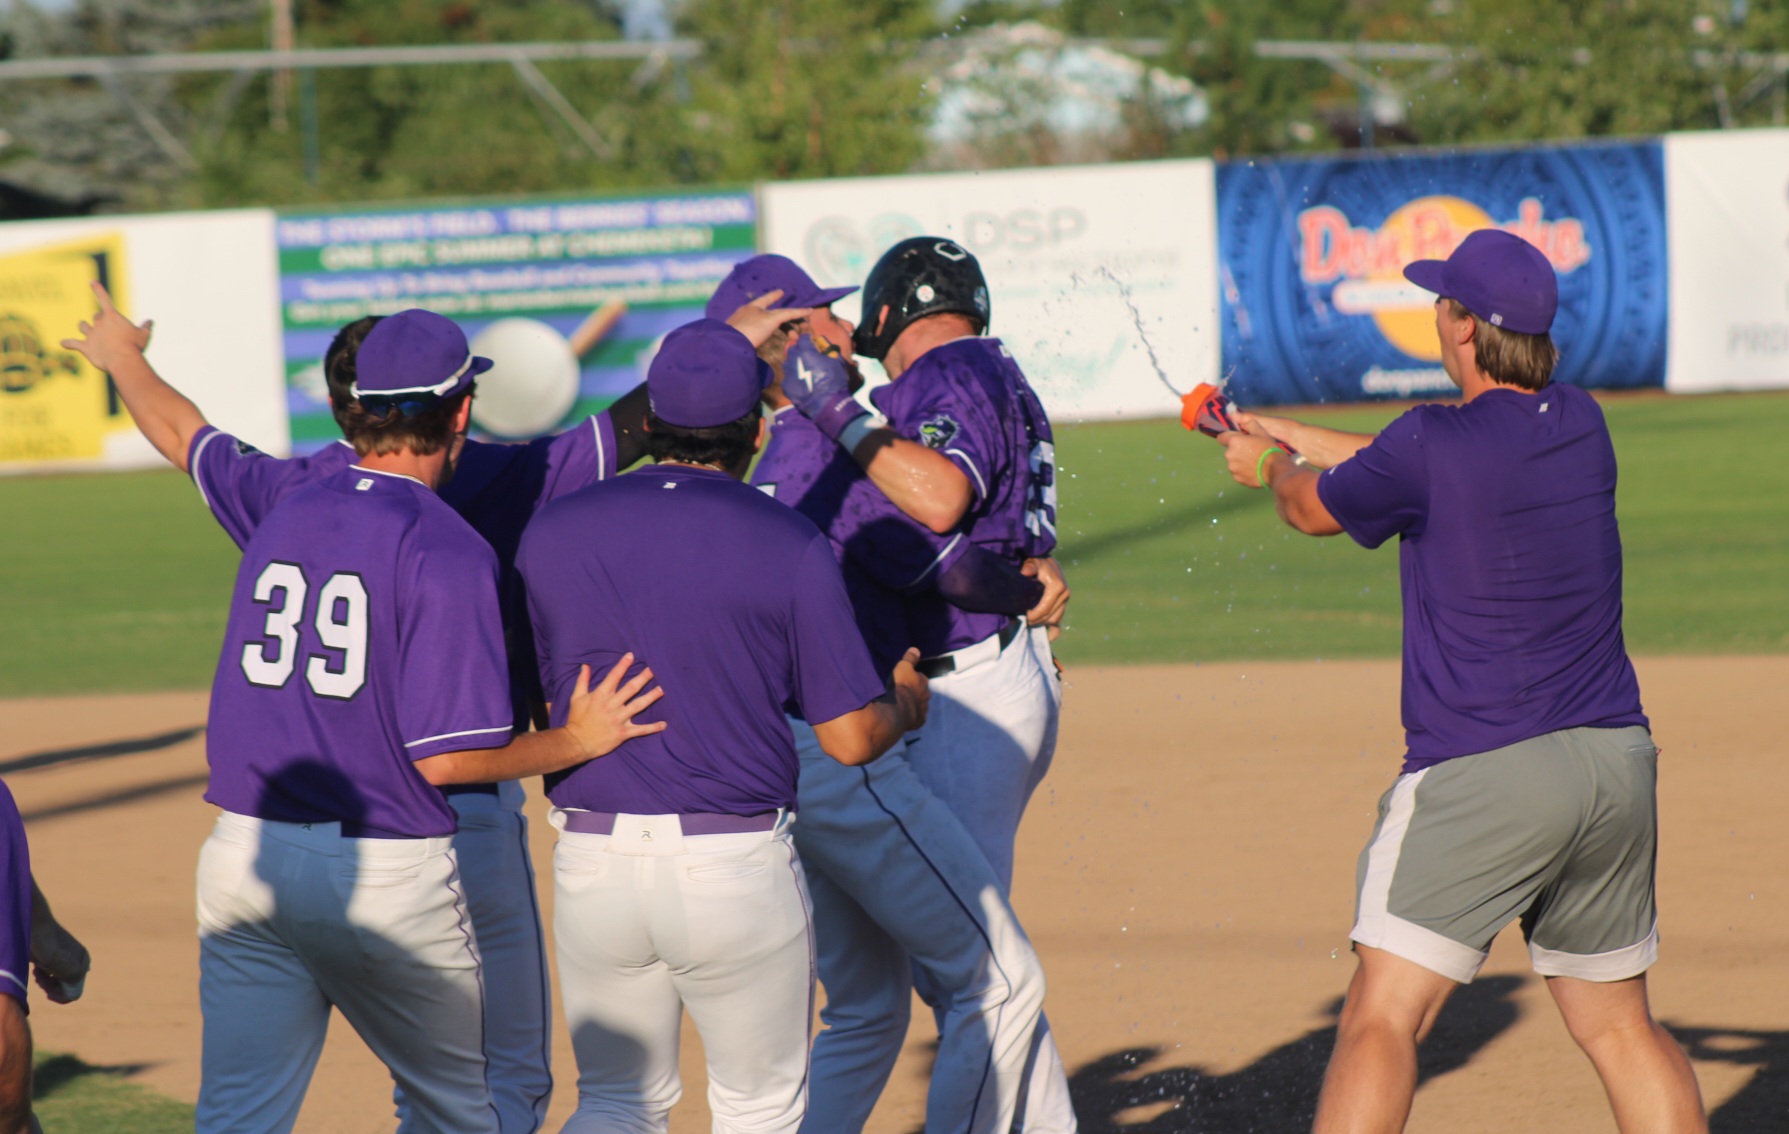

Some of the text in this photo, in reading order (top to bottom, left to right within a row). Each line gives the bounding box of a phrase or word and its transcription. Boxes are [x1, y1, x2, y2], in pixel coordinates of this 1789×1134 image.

[963, 208, 1088, 253] DSP
[1298, 206, 1403, 284] Don
[1724, 321, 1789, 357] PRO
[240, 559, 370, 702] 39
